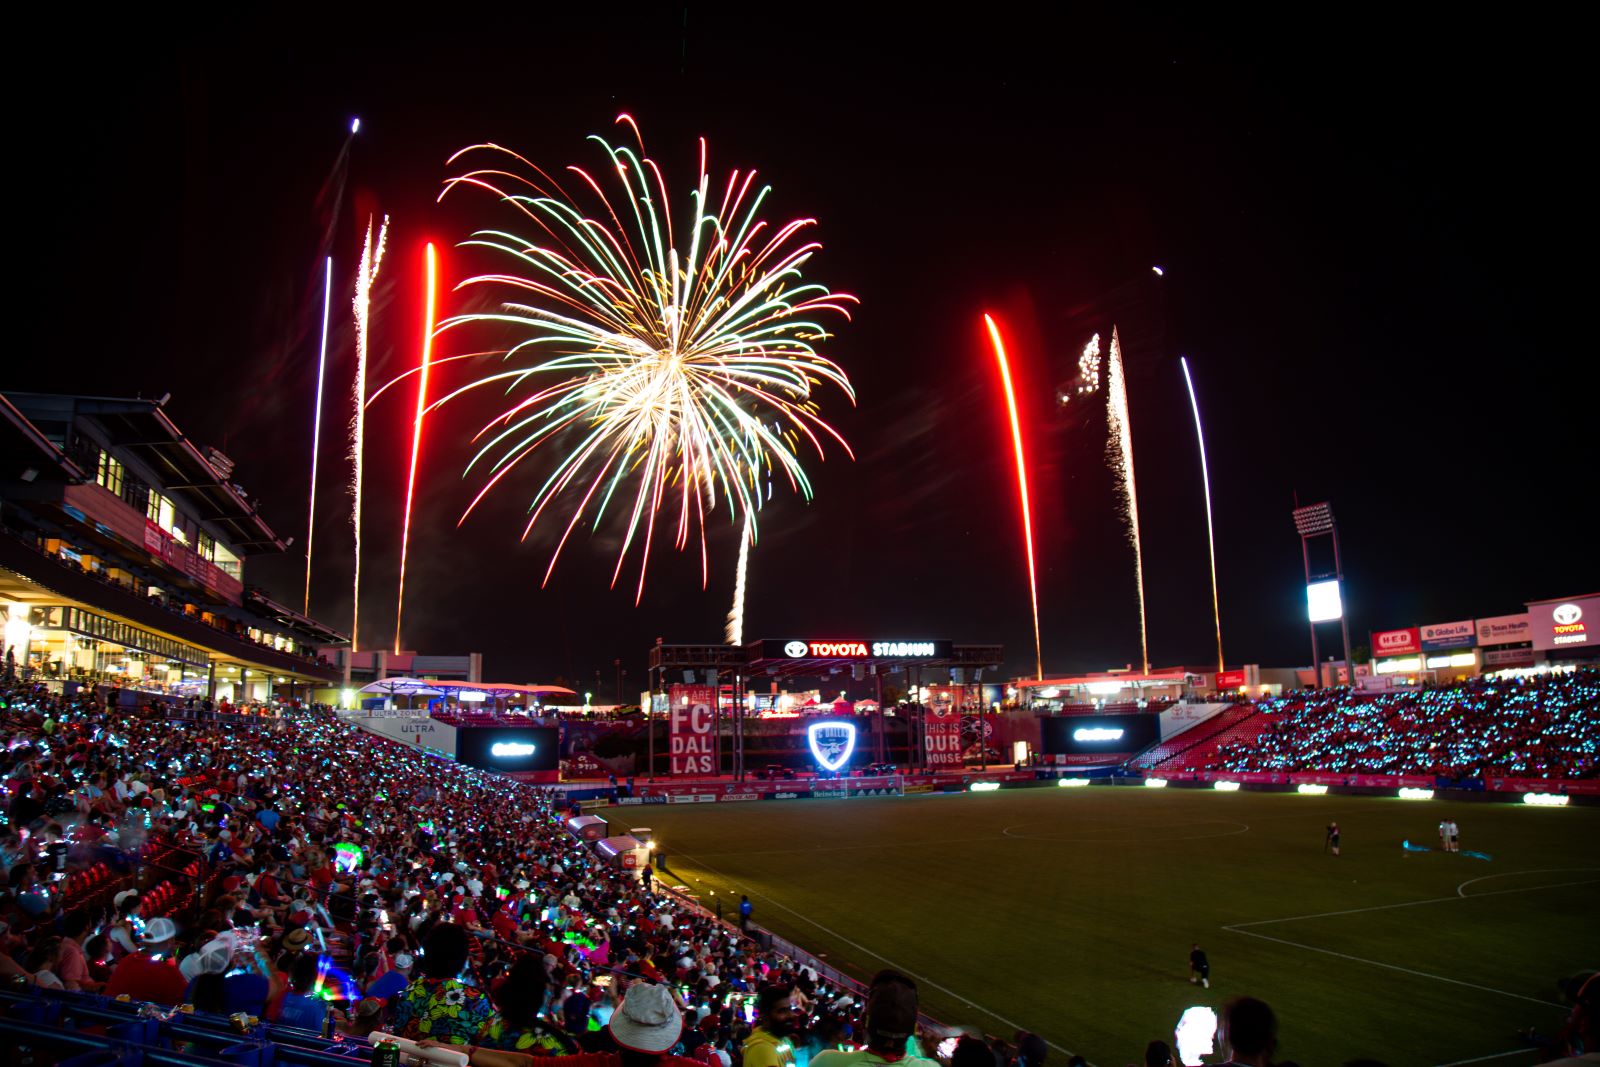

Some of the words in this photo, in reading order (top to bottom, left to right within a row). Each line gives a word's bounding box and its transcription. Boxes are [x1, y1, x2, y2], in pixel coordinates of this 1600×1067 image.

[1435, 628, 1455, 637] Globe
[1455, 625, 1468, 634] Life
[1509, 622, 1528, 630] Health
[1554, 624, 1585, 634] TOYOTA
[810, 643, 868, 656] TOYOTA
[873, 642, 935, 657] STADIUM
[673, 690, 688, 700] WE
[692, 690, 711, 700] ARE
[672, 704, 711, 735] FC
[401, 725, 435, 733] ULTRA
[925, 723, 946, 734] THIS
[950, 723, 960, 733] IS
[672, 737, 712, 754] DAL
[925, 735, 960, 752] OUR
[926, 752, 962, 764] HOUSE
[672, 755, 712, 774] LAS
